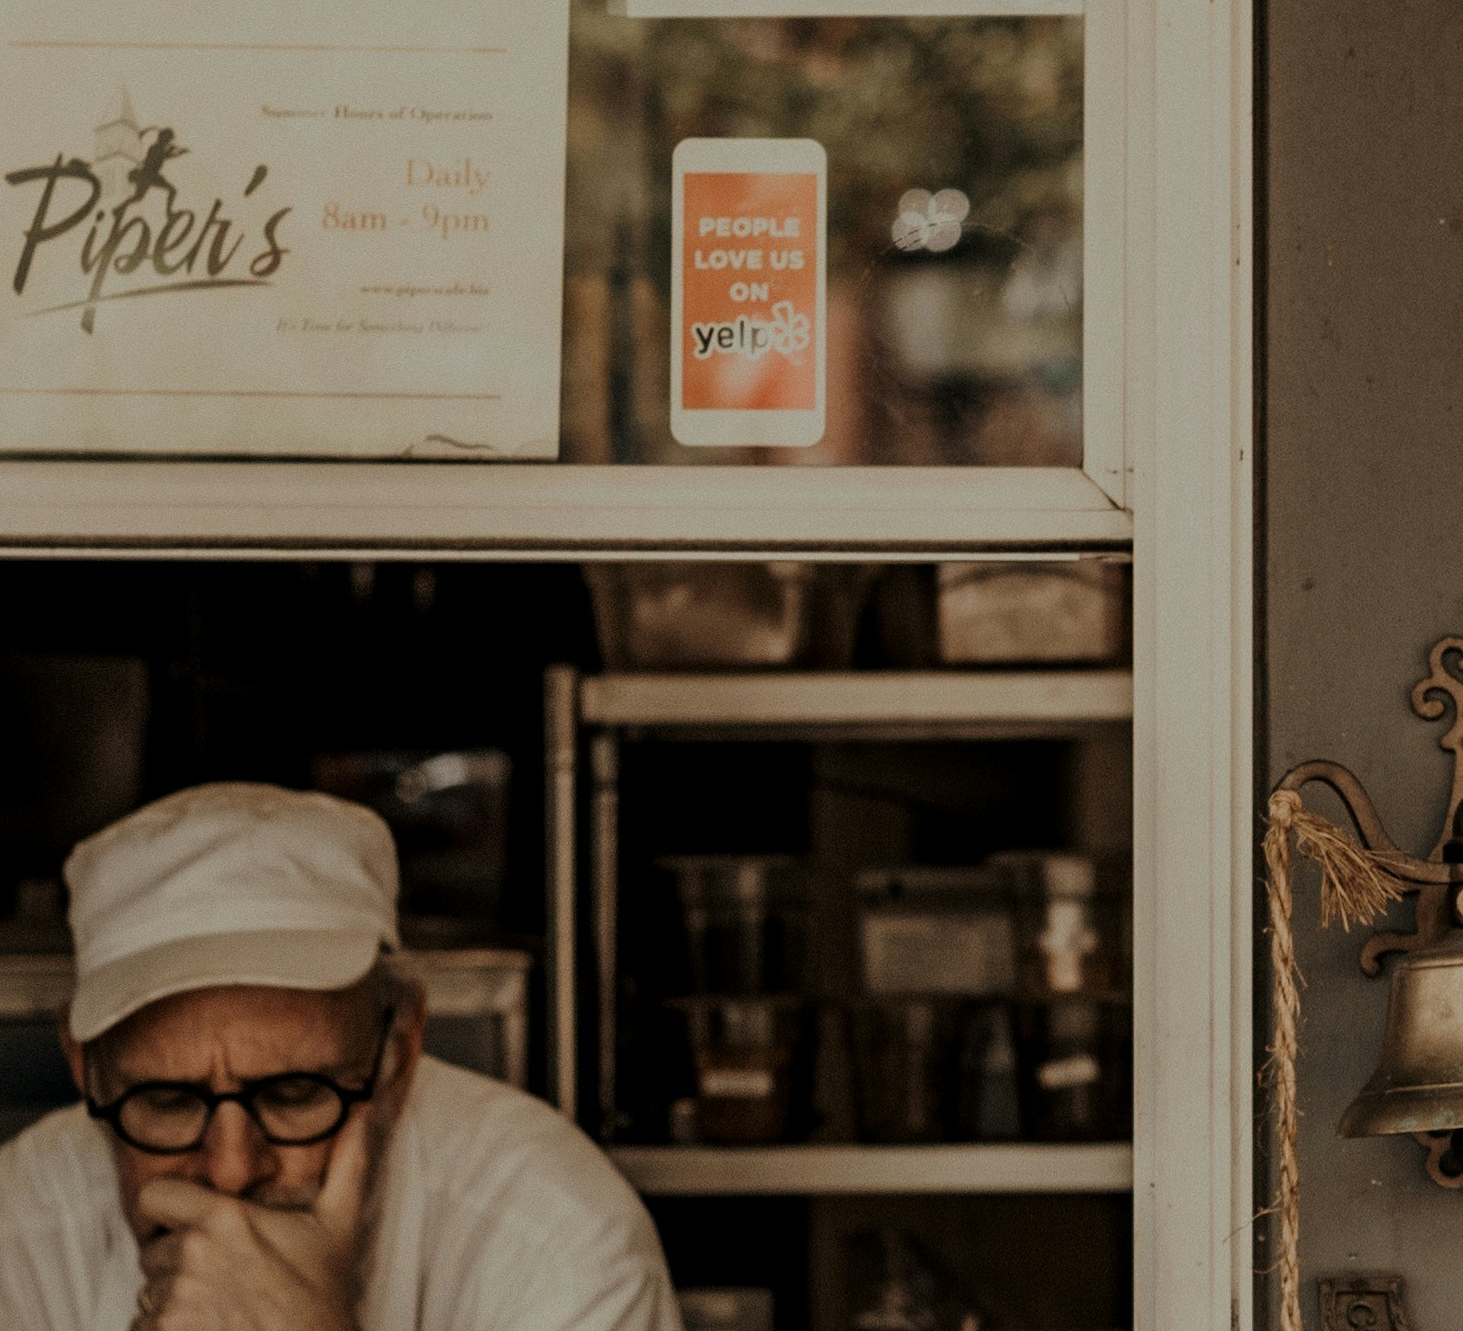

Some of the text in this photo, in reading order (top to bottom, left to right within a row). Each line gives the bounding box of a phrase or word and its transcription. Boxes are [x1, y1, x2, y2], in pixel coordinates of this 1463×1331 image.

[334, 105, 383, 119] Hours
[389, 106, 404, 119] of
[410, 106, 493, 123] Operation
[408, 157, 491, 195] Daily
[321, 202, 387, 231] 8am
[422, 203, 490, 241] 9pm
[698, 217, 800, 238] PEOPLE
[5, 153, 293, 336] Piper's
[694, 250, 805, 270] LOVE US
[730, 282, 769, 302] ON
[695, 320, 769, 356] yelp
